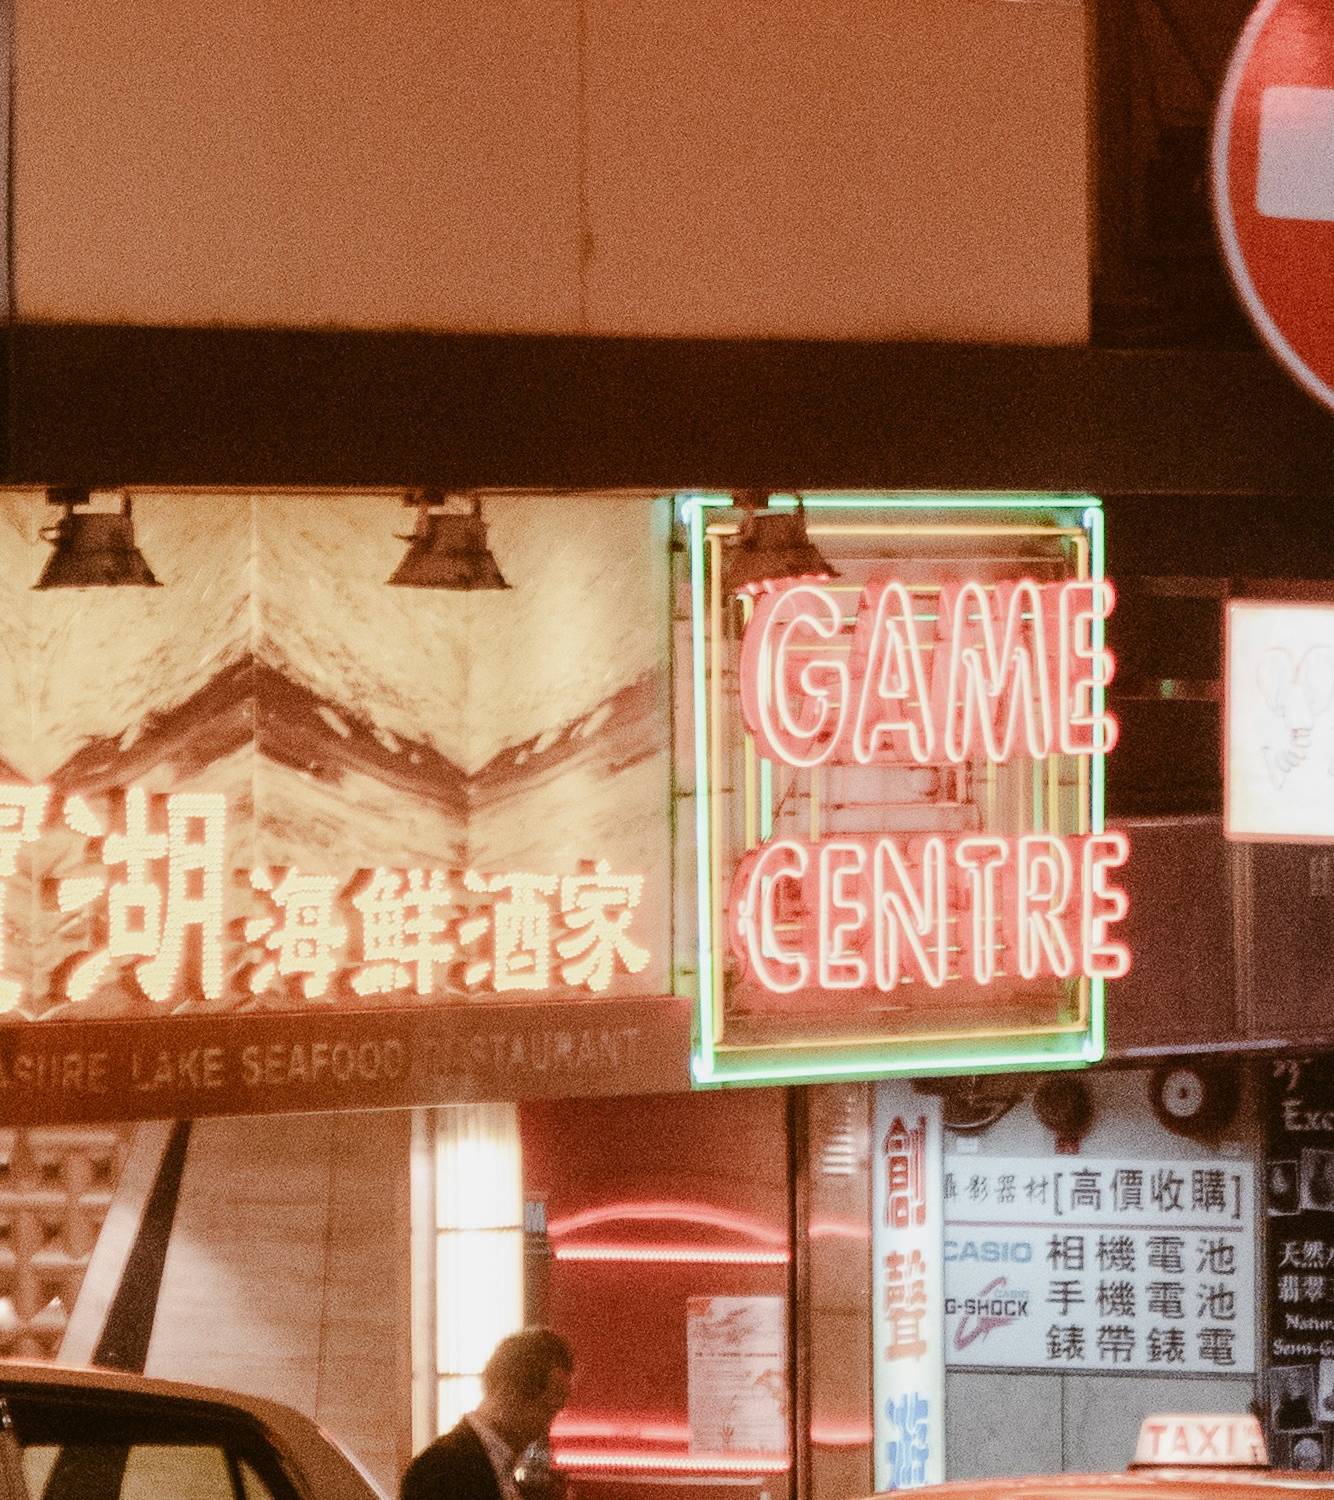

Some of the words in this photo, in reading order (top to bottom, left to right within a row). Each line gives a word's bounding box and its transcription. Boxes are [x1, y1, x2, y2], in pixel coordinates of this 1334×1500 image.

[743, 577, 1119, 769] GAME
[735, 834, 1132, 993] CENTRE
[131, 1045, 225, 1092] LAKE
[241, 1038, 403, 1088] SEAFOOD
[943, 1239, 1035, 1264] CASIO
[1045, 1233, 1237, 1276] 相機電池
[944, 1297, 1030, 1318] G-SHOCK
[1044, 1279, 1237, 1321] 手機電池
[1146, 1424, 1238, 1457] TAXI
